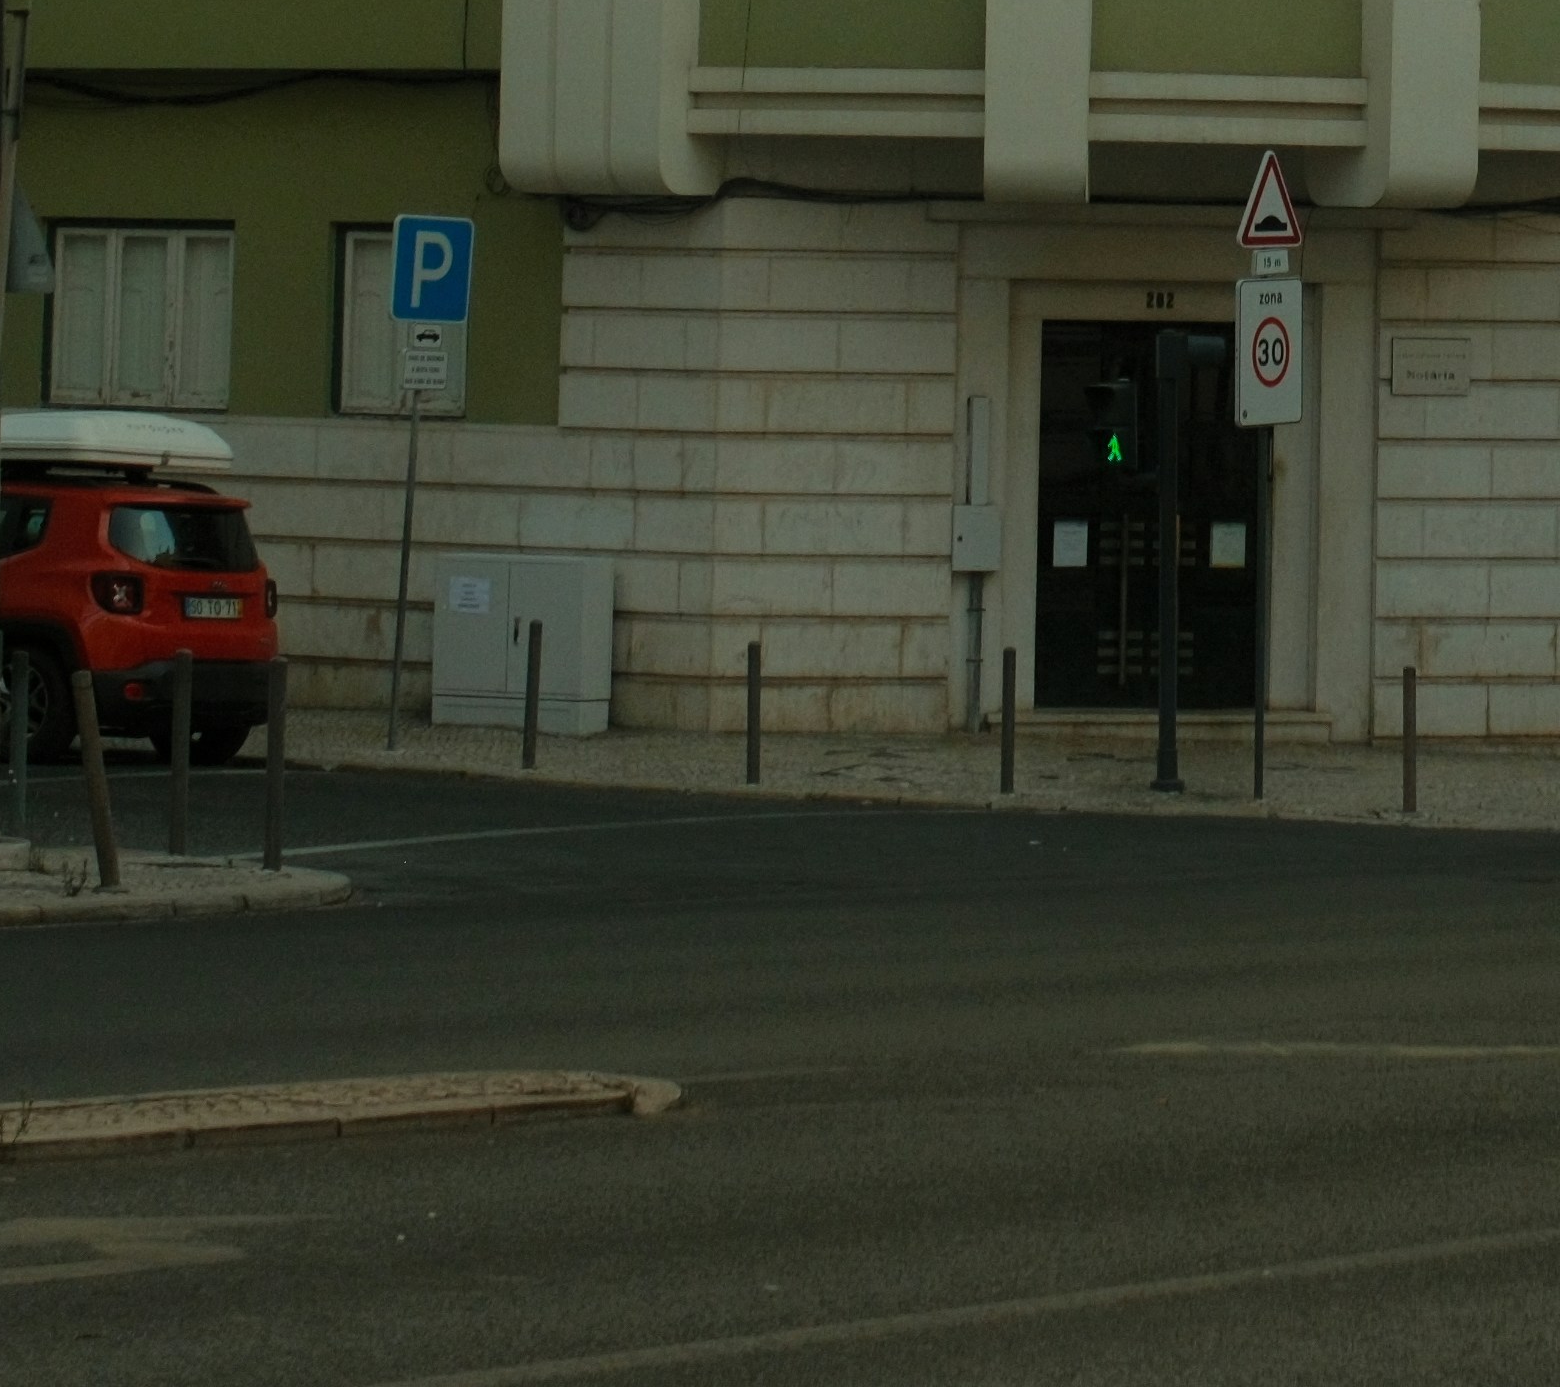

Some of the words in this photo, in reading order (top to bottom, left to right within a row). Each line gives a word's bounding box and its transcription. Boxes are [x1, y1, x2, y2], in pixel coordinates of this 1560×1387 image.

[410, 230, 454, 308] P
[1259, 291, 1283, 305] zona
[1257, 338, 1284, 367] 30
